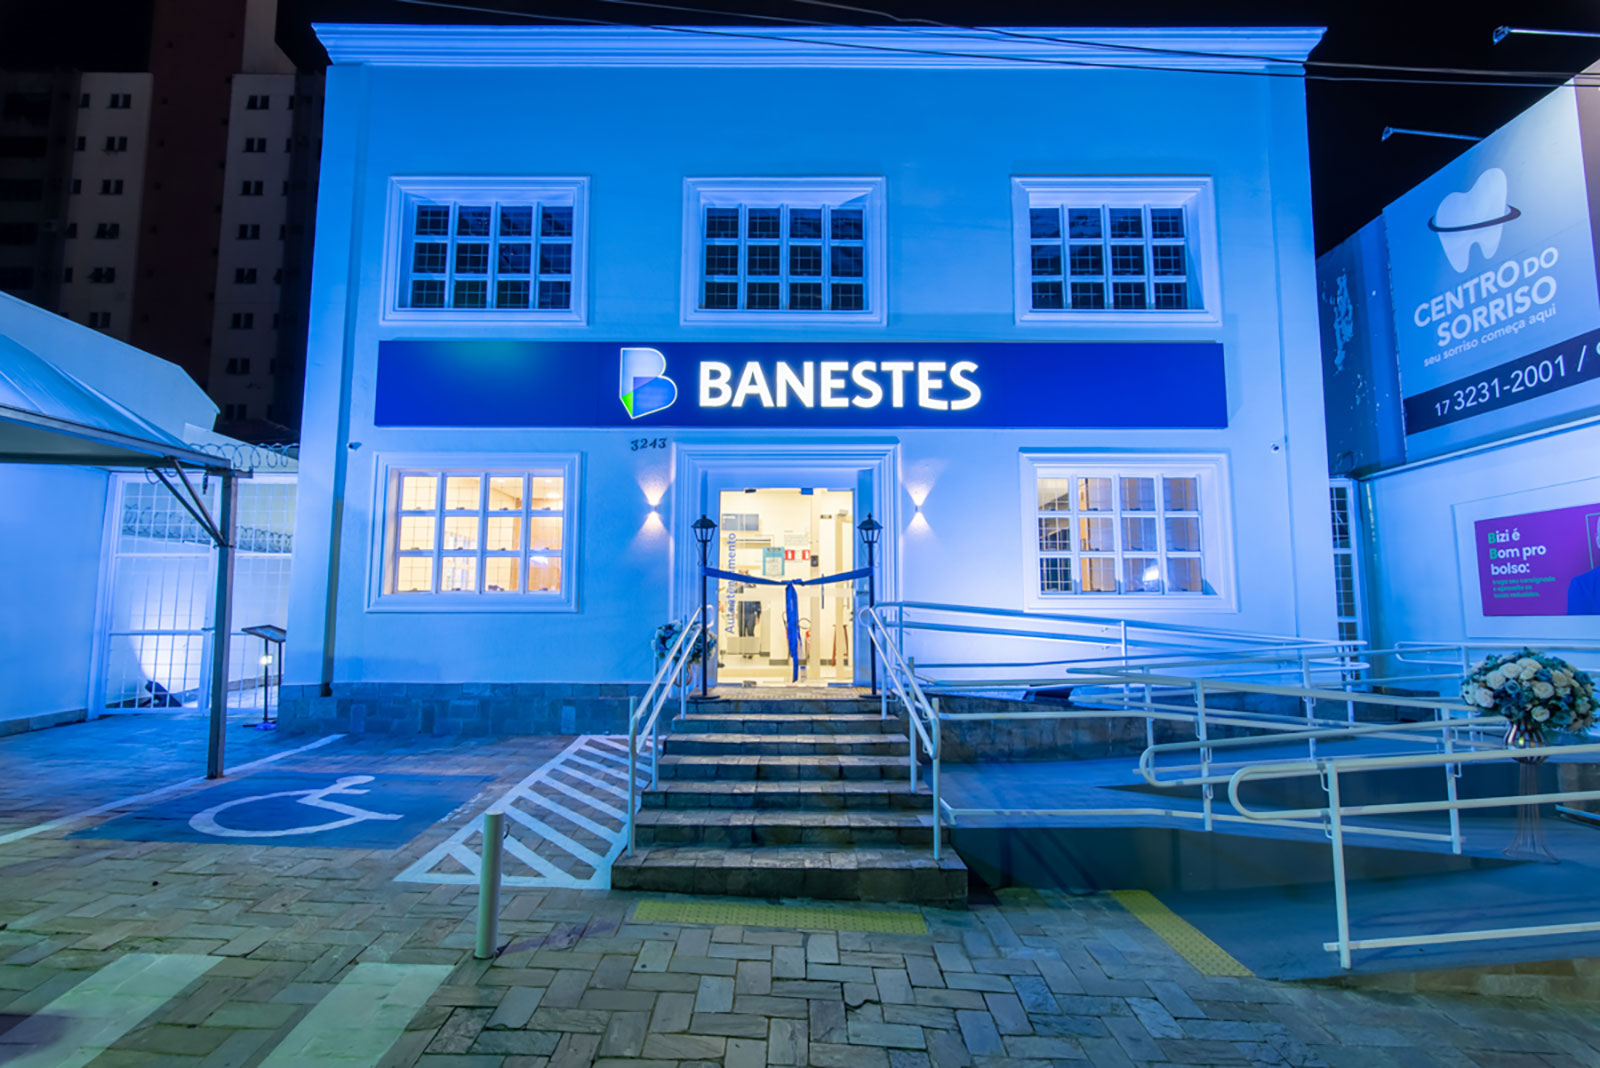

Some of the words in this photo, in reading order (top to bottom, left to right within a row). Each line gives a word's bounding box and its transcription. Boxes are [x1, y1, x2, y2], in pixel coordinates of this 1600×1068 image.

[1414, 260, 1520, 328] CENTRO
[1522, 247, 1559, 278] DO
[1437, 275, 1558, 347] SORRISO
[1423, 352, 1442, 367] seu
[1443, 338, 1479, 360] sorriso
[1480, 319, 1526, 345] começa
[1528, 303, 1557, 325] aqui
[698, 360, 982, 411] BANESTES
[1434, 399, 1451, 417] 17
[1453, 354, 1566, 411] 3231-2001
[630, 437, 668, 452] 3243
[1487, 529, 1510, 544] Bizi
[1511, 528, 1520, 541] é
[1489, 547, 1520, 560] Bom
[1521, 545, 1547, 561] pro
[724, 532, 737, 635] Autoatenimento
[1490, 562, 1530, 576] bolso:
